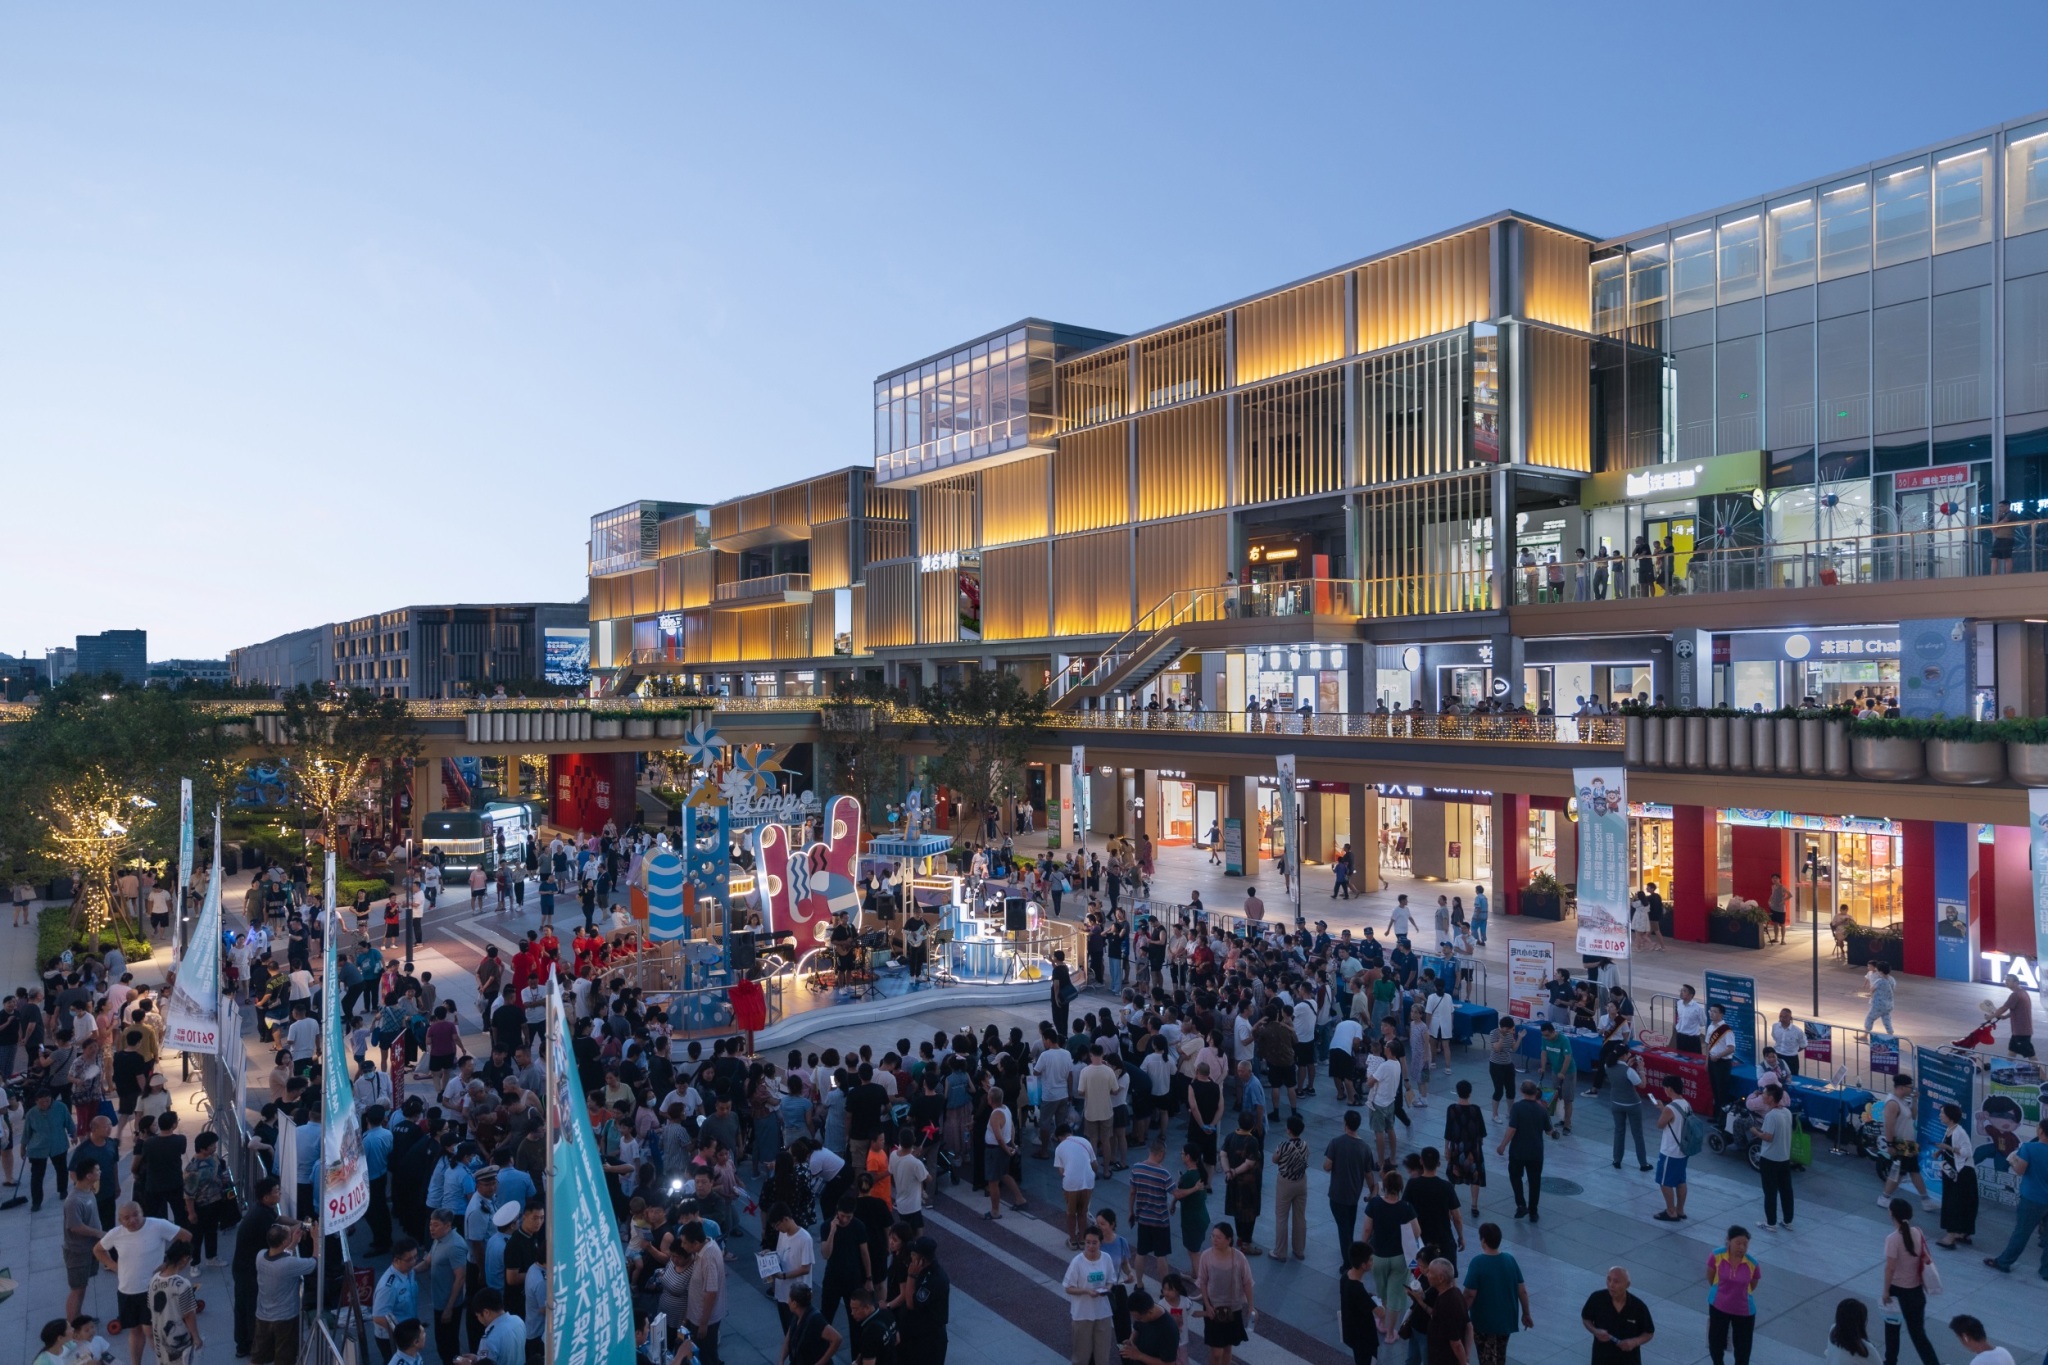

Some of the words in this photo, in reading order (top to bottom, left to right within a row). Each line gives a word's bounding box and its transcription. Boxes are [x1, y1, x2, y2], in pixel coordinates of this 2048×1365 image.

[1821, 639, 1863, 654] 茶百道
[1680, 661, 1691, 694] 茶百道
[595, 780, 611, 810] 街巷
[1981, 951, 2039, 988] TA
[1978, 1166, 2022, 1190] 提高
[329, 1186, 362, 1219] 96110
[152, 1275, 184, 1291] Giraffe
